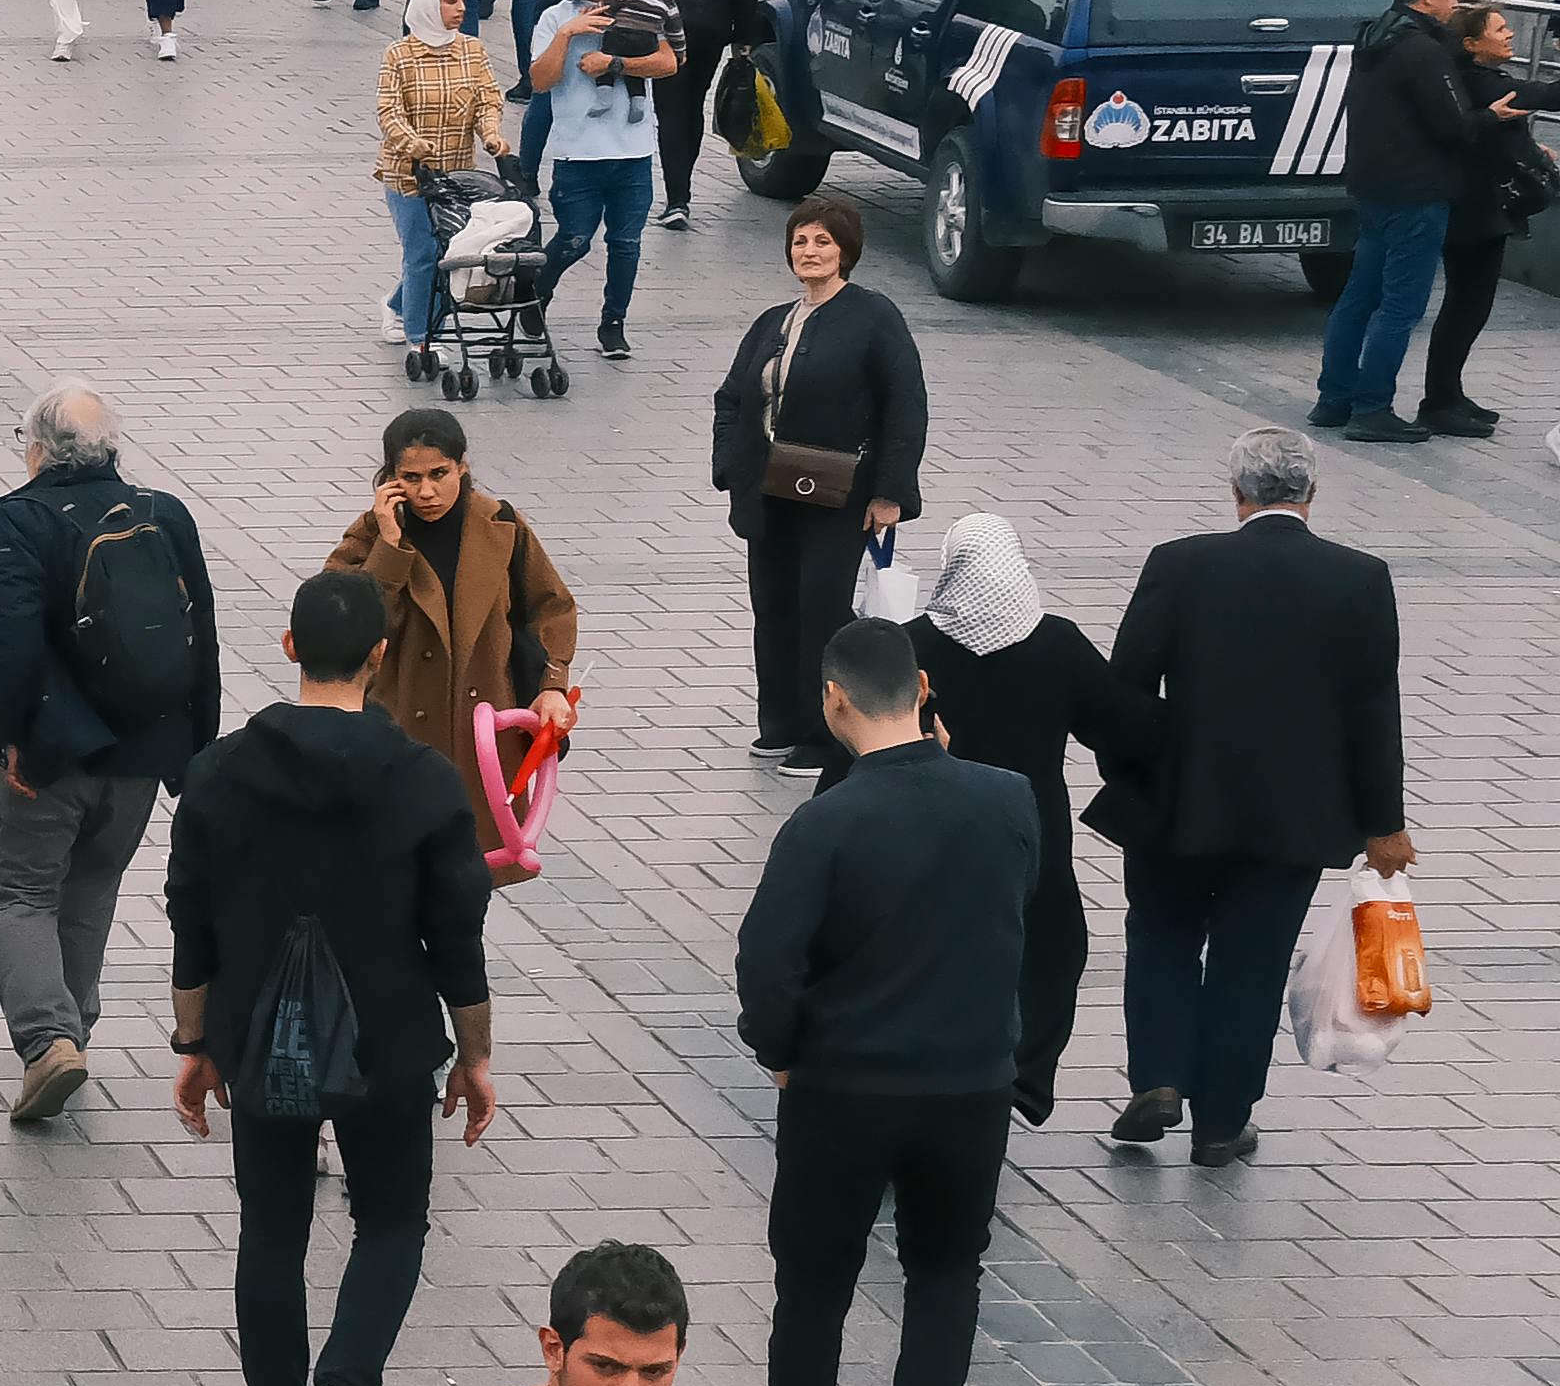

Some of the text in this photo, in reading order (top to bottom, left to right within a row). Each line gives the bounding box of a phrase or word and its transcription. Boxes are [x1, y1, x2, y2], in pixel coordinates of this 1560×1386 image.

[1151, 119, 1256, 141] ZABITA
[1203, 224, 1228, 244] 34
[1239, 224, 1263, 244] BA
